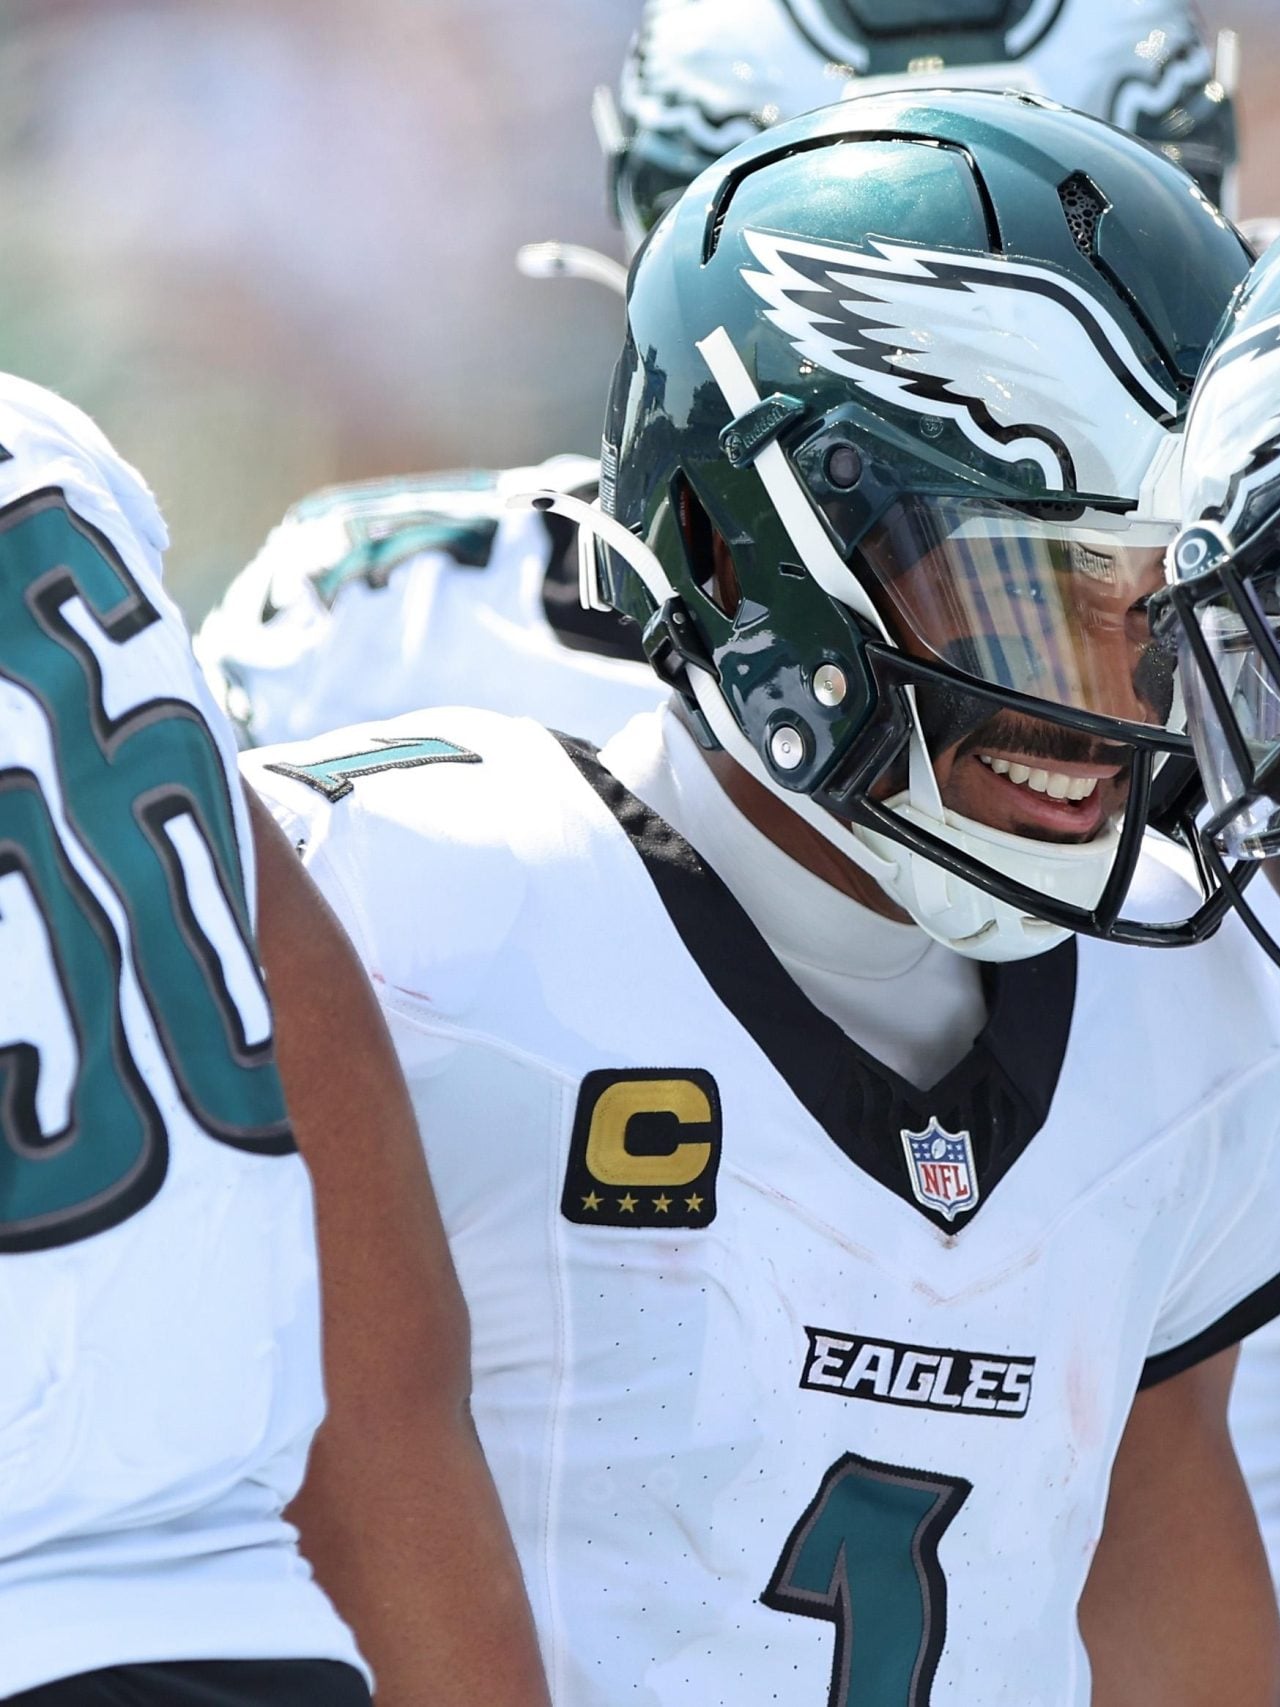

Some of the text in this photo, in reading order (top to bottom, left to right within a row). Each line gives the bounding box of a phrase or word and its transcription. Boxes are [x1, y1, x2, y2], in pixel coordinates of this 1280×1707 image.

[586, 1079, 712, 1186] C
[920, 1163, 969, 1201] NFL
[805, 1334, 1034, 1413] EAGLES
[759, 1450, 974, 1707] 1
